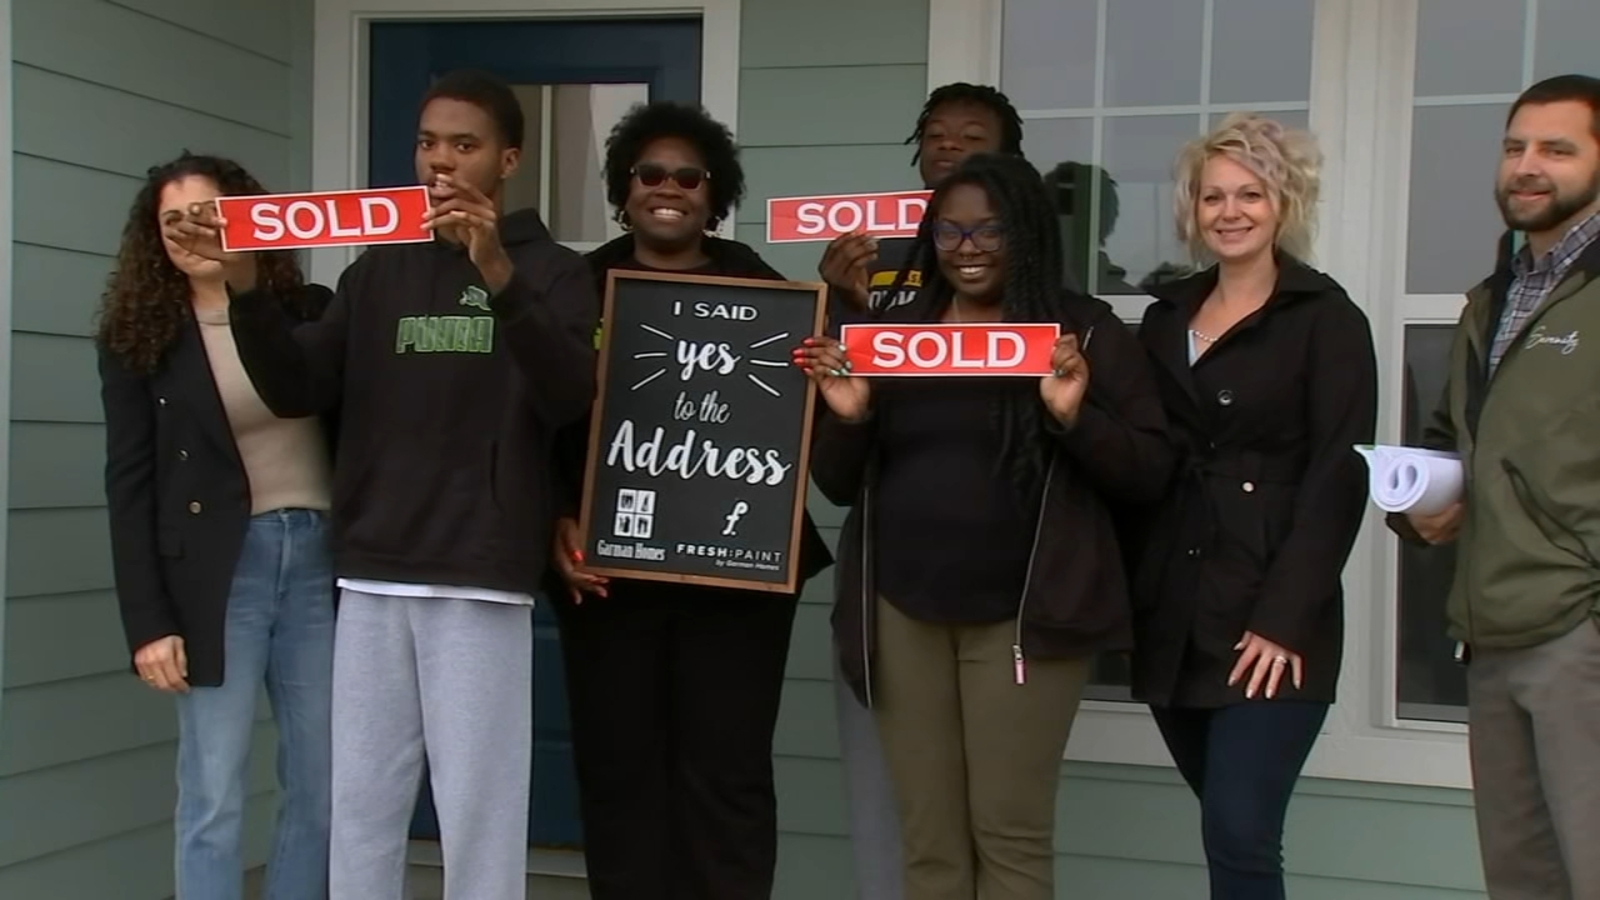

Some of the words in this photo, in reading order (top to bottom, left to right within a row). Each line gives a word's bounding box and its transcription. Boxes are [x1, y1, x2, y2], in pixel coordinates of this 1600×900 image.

[250, 196, 399, 242] SOLD
[796, 198, 928, 234] SOLD
[673, 301, 682, 316] I
[694, 302, 759, 321] SAID
[676, 340, 741, 381] yes
[872, 331, 1026, 368] SOLD
[674, 391, 696, 421] to
[699, 390, 731, 423] the
[606, 419, 791, 486] Address
[635, 542, 666, 561] Homes
